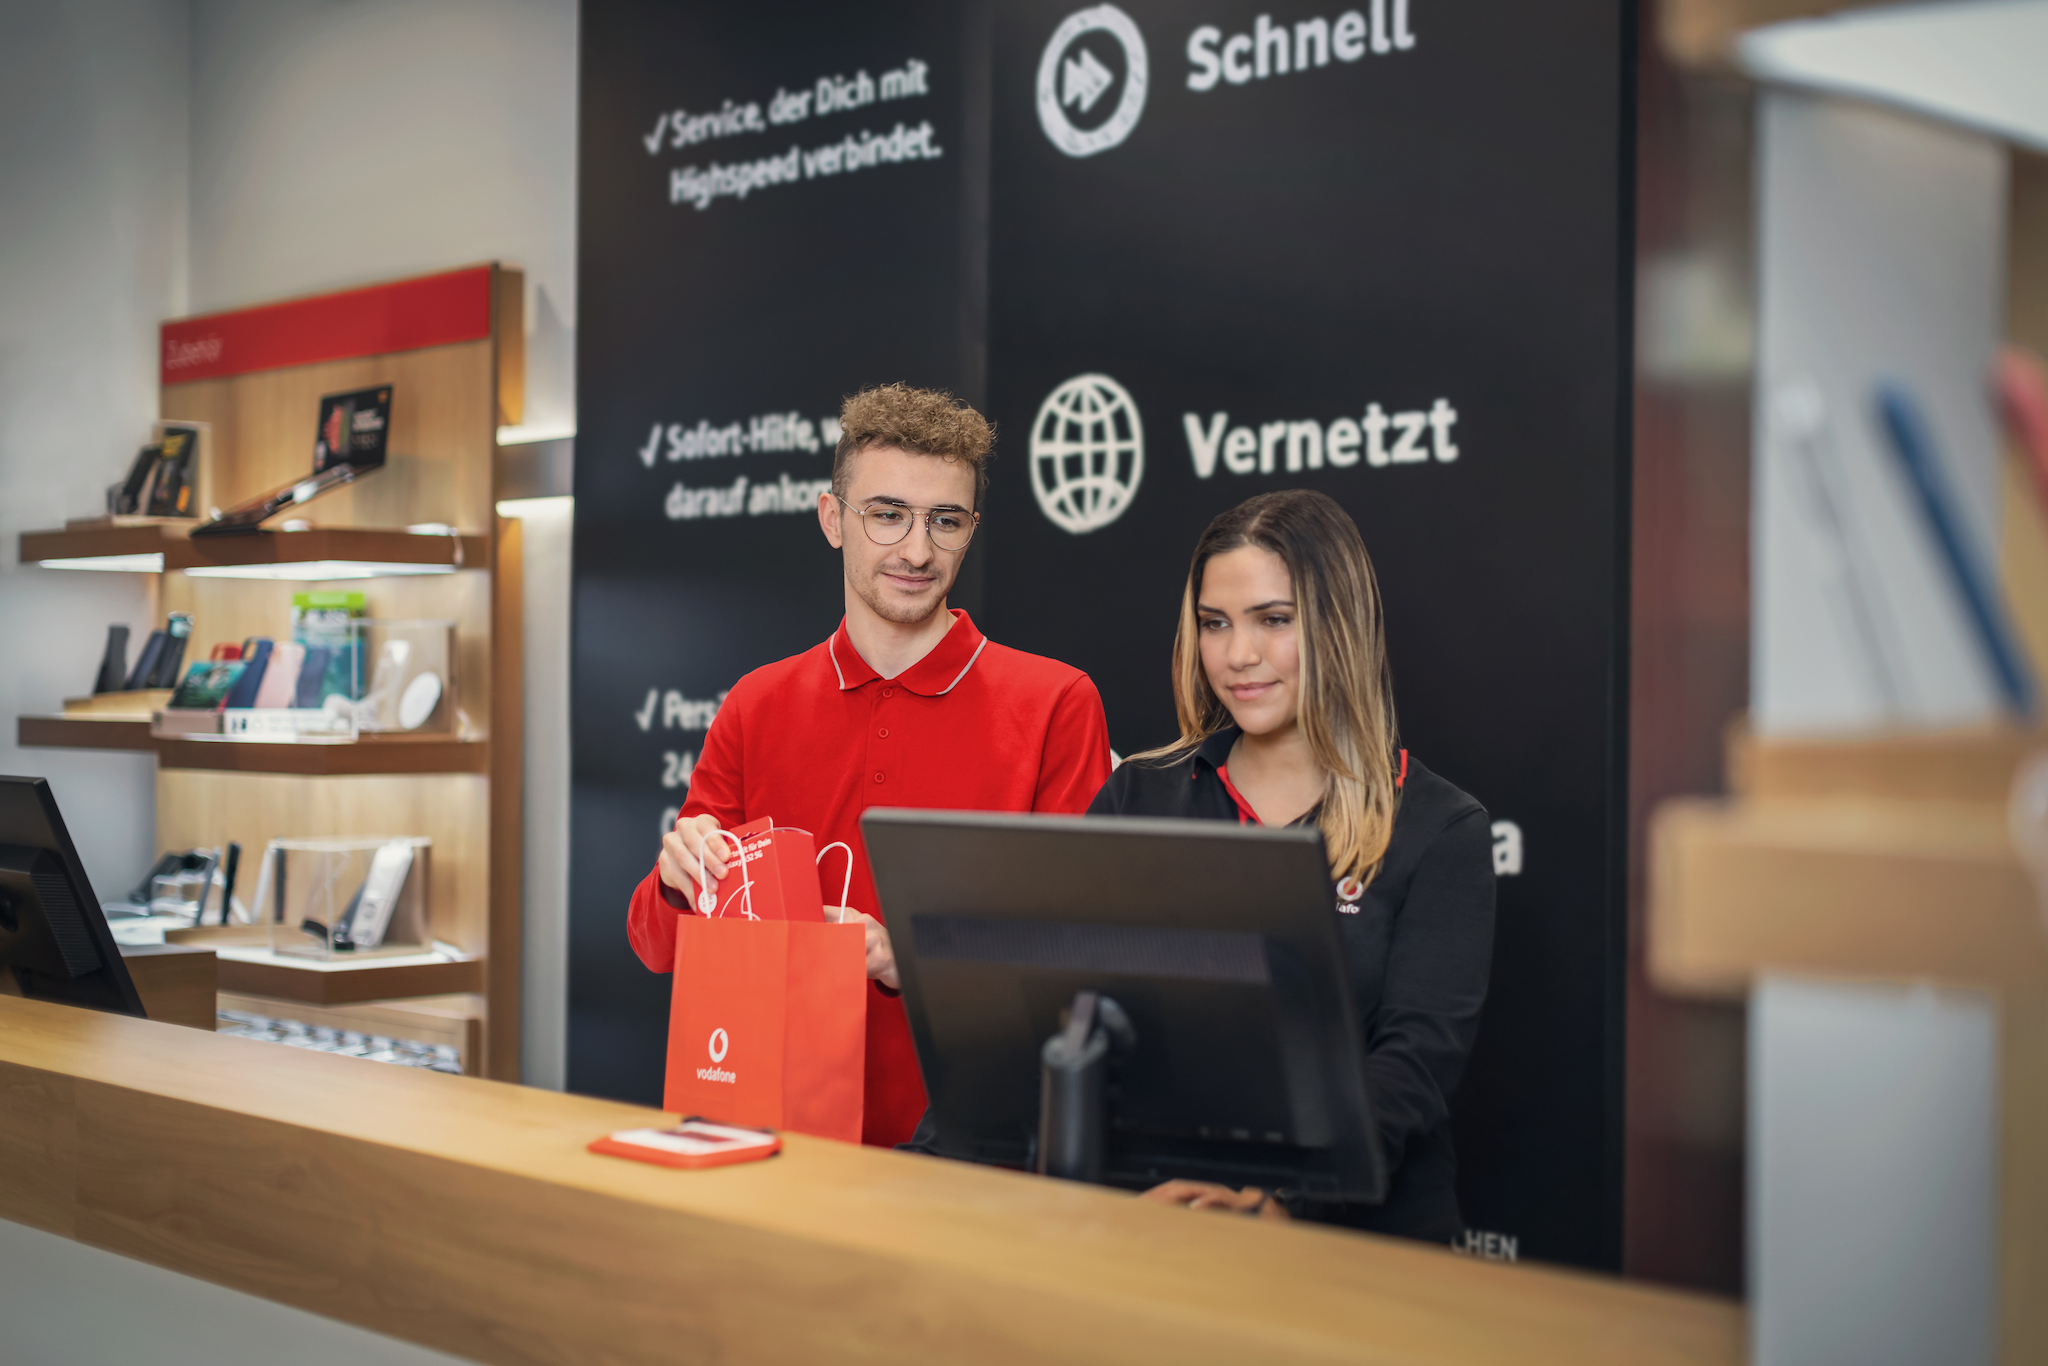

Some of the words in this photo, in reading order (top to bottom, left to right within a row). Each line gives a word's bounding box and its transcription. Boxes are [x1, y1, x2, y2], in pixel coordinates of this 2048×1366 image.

[1186, 0, 1416, 92] Schnell
[670, 100, 766, 149] Service,
[768, 88, 812, 125] der
[815, 69, 875, 115] Dich
[880, 58, 929, 100] mit
[670, 146, 800, 210] Highspeed
[802, 120, 943, 178] verbindet.
[666, 410, 820, 463] Sofort-Hilfe,
[1183, 398, 1459, 479] Vernetzt
[665, 474, 748, 521] darauf
[696, 1066, 737, 1084] vodafone
